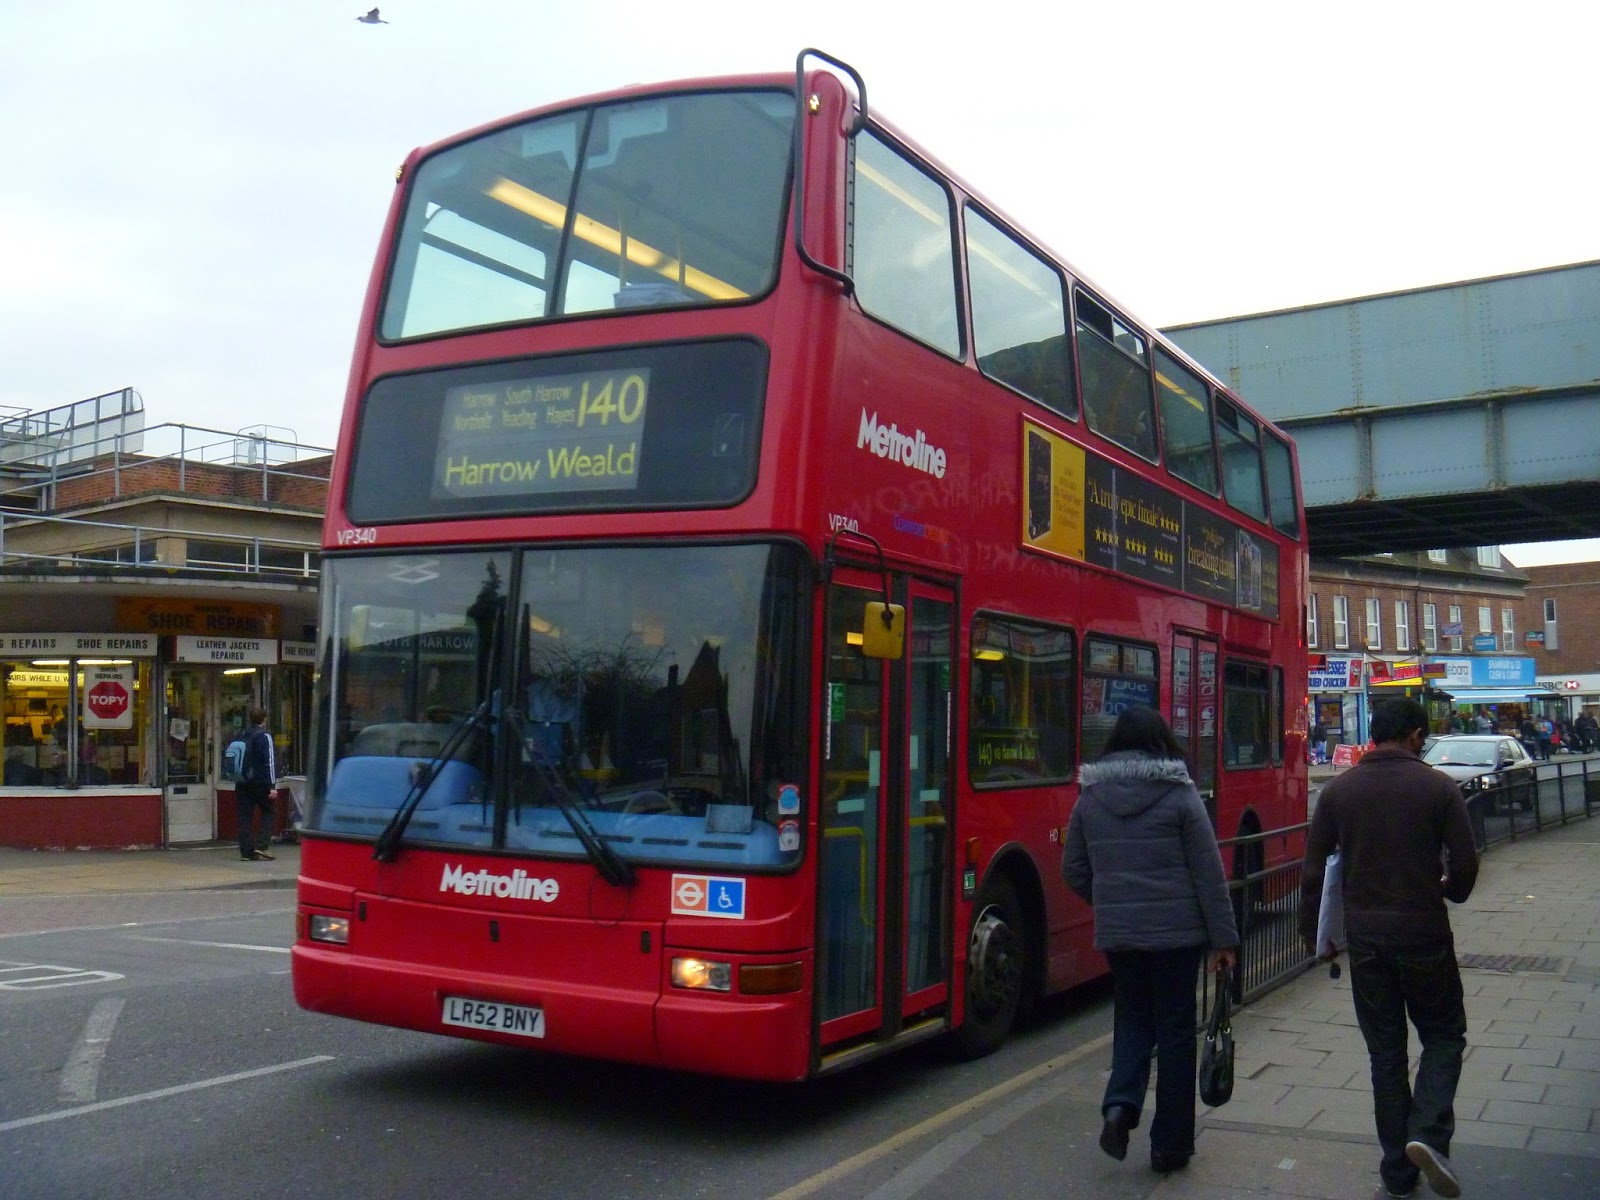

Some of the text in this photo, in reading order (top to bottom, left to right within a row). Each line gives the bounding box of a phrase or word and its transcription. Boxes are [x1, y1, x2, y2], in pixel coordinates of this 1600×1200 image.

[577, 374, 646, 428] 140
[857, 406, 947, 479] Metroline
[444, 442, 637, 487] Harrow Weald
[1121, 497, 1136, 525] epic
[829, 512, 859, 533] VP340
[337, 527, 377, 545] VP340
[149, 613, 195, 629] SHOE
[11, 638, 57, 649] REPAIRS
[77, 639, 148, 650] SHOE REPAIRS
[196, 639, 260, 651] LEATHER JACKETS
[210, 651, 245, 661] REPAIRED
[1447, 664, 1469, 676] ebara
[90, 695, 126, 706] TOPY
[440, 863, 560, 903] Metroline
[450, 998, 540, 1033] LR52 BNY
